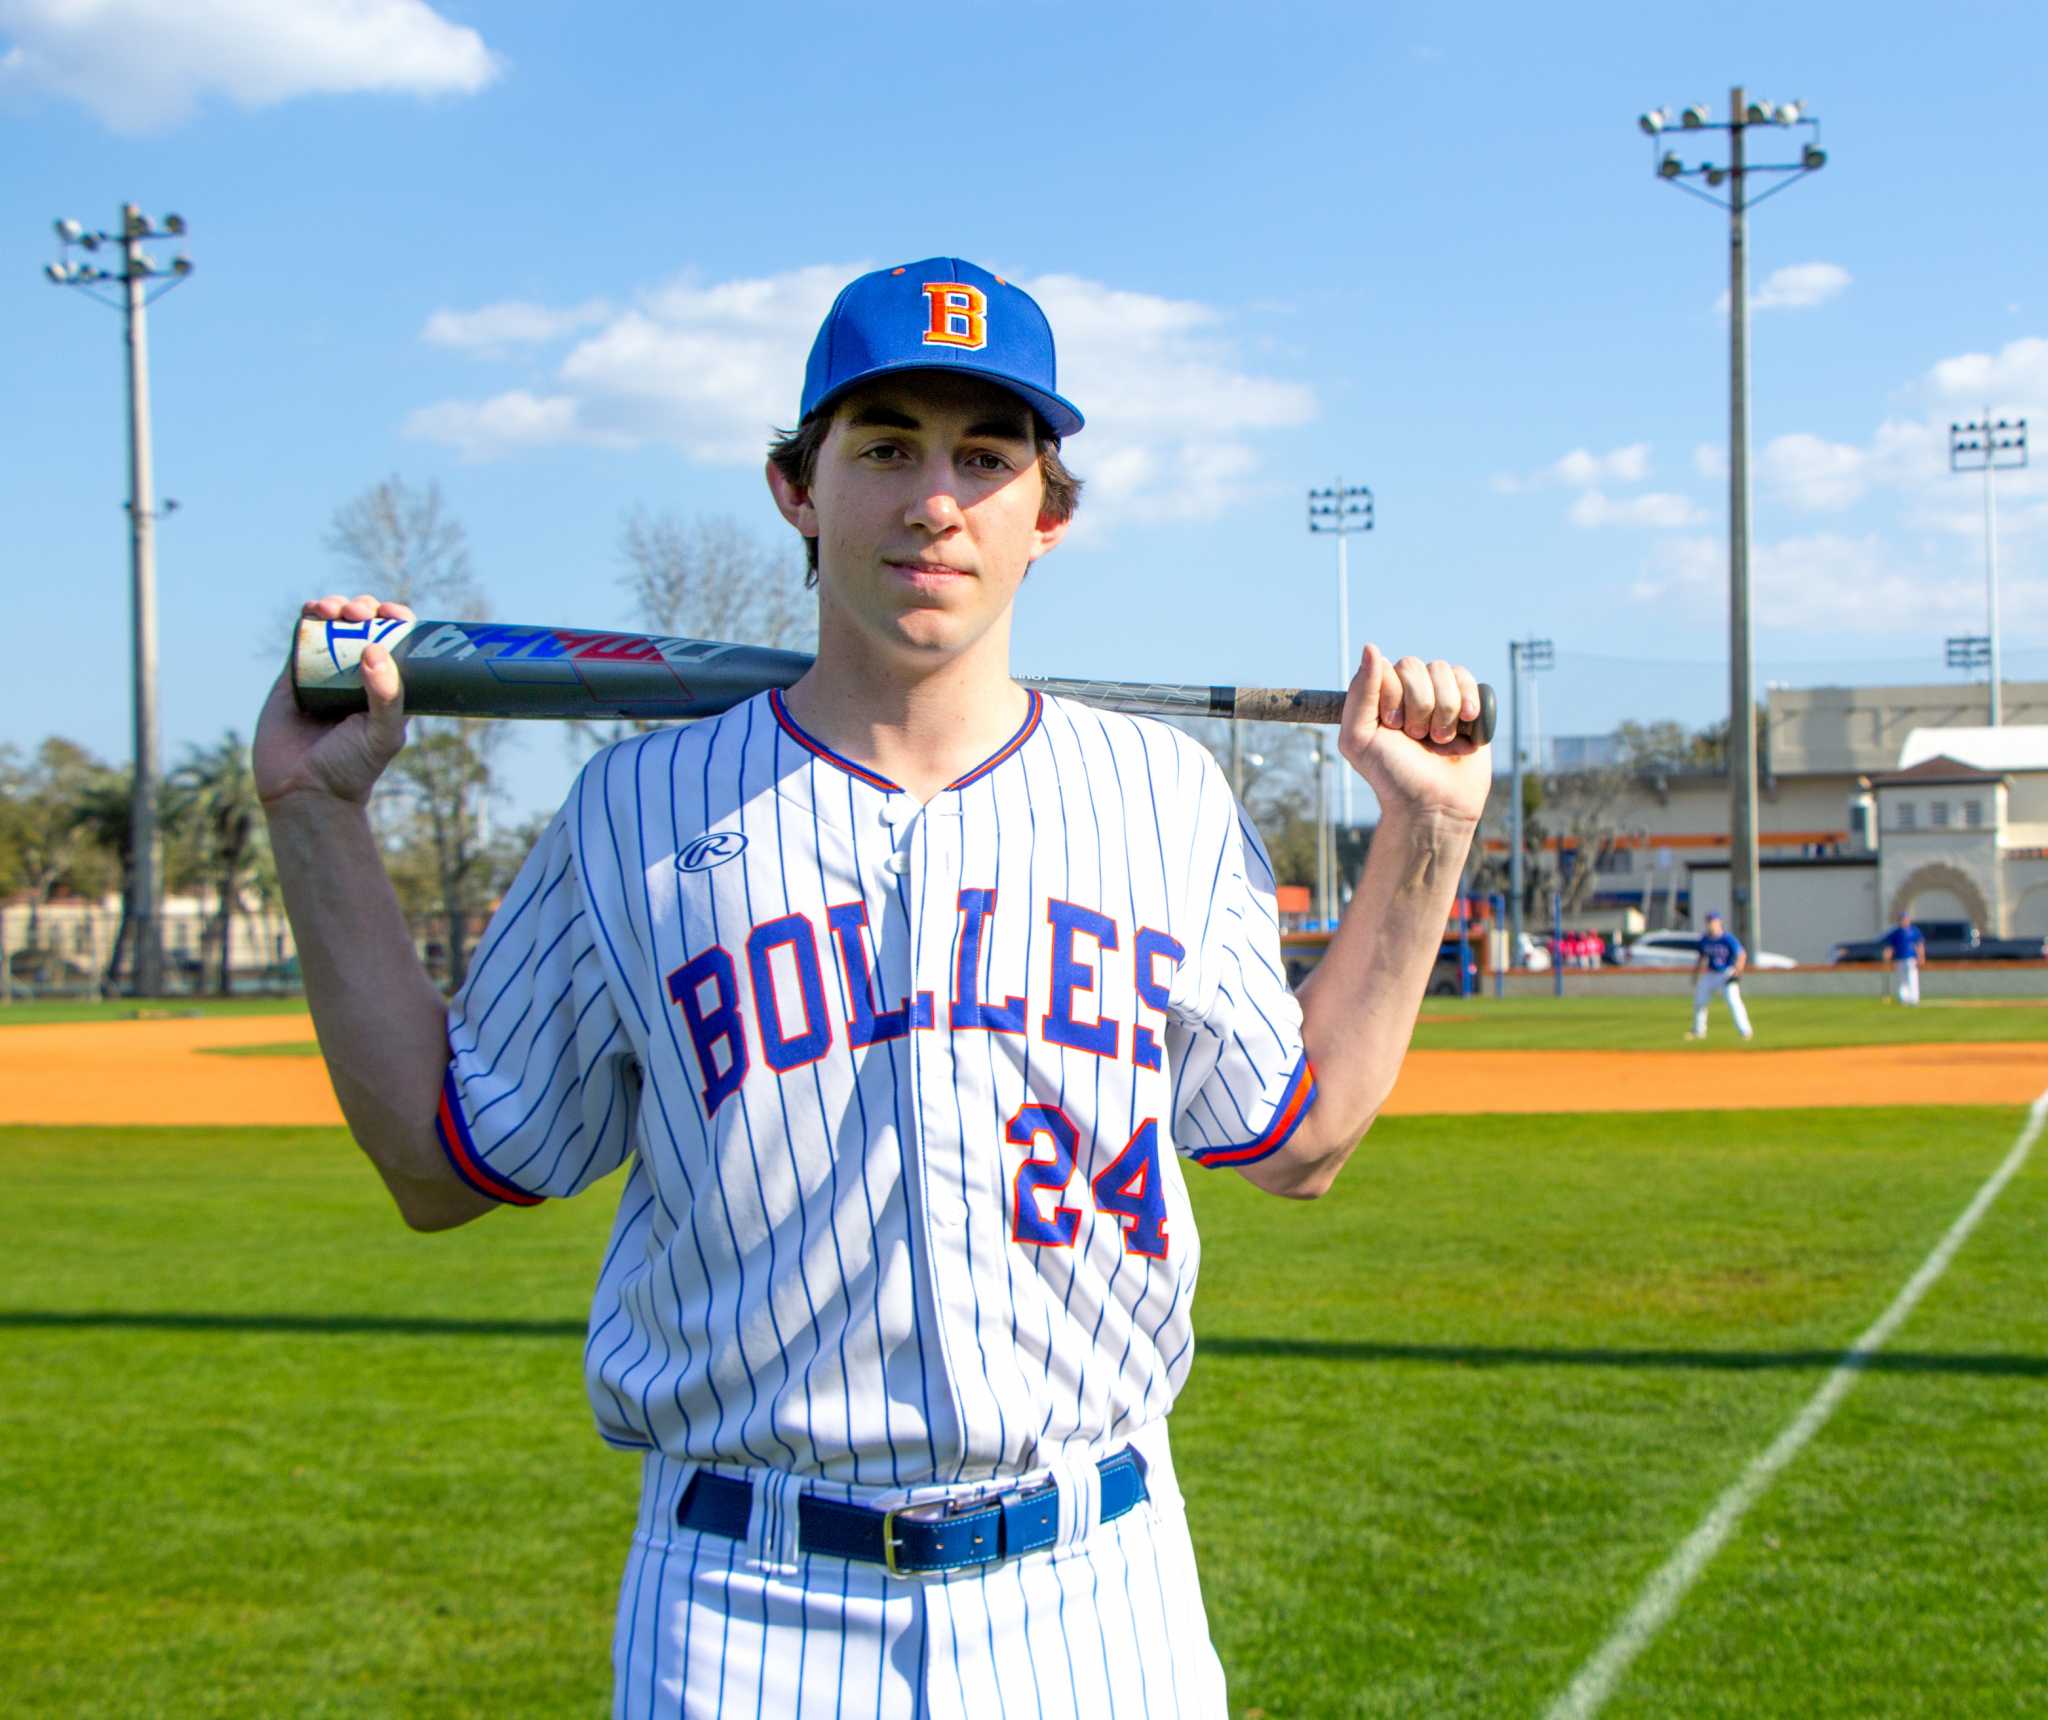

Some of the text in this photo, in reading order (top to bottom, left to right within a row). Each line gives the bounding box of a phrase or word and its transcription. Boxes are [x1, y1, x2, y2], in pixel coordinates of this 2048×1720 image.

[922, 282, 988, 351] B
[682, 834, 734, 869] R
[666, 887, 1186, 1120] BOLLES
[1005, 1103, 1169, 1260] 24
